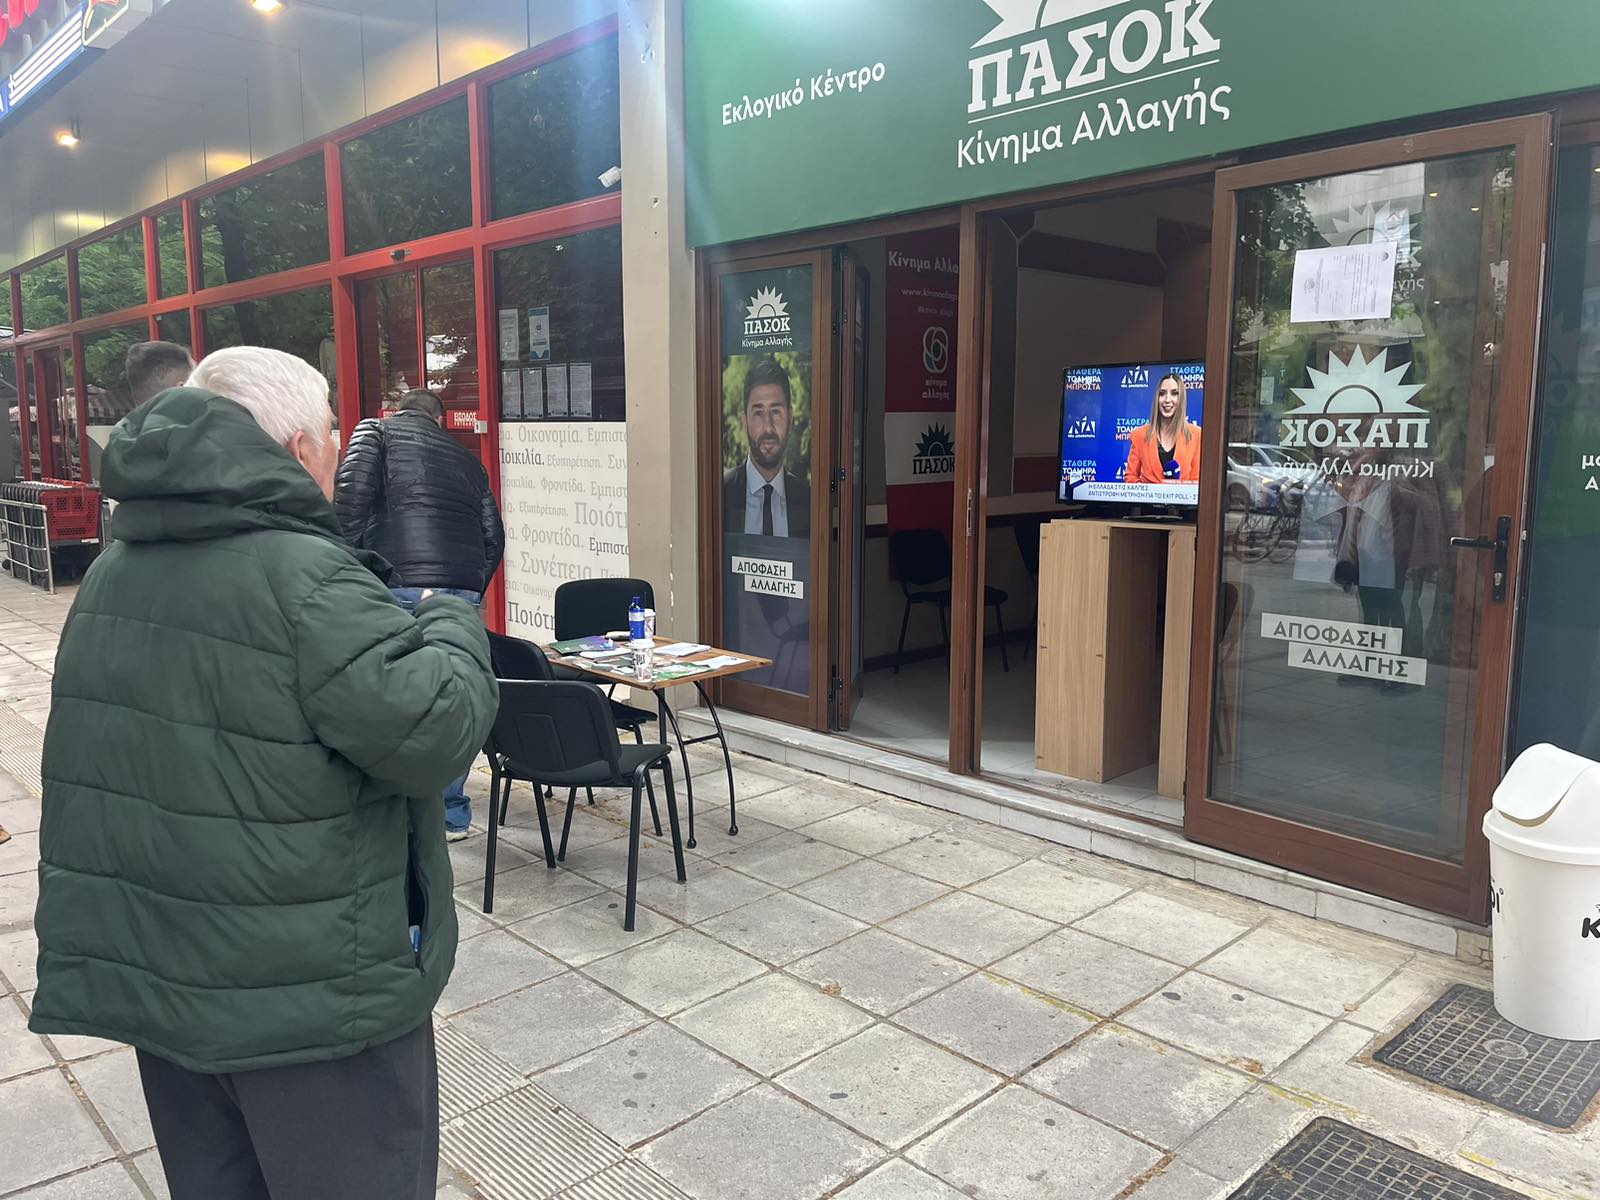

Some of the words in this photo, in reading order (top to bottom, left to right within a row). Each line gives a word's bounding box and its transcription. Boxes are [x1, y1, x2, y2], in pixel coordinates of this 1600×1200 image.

[967, 0, 1221, 114] ΠΑΣΟΚ
[721, 78, 804, 126] Εκλογικό
[810, 62, 886, 100] Κέντρο
[957, 123, 1063, 168] Κίνημα
[1072, 78, 1232, 145] Αλλαγής
[888, 250, 931, 273] Κίνημα
[744, 317, 791, 335] ΠΑΣΟΚ
[742, 338, 764, 349] Κίνημα
[765, 335, 793, 347] Αλλαγής
[1066, 383, 1101, 391] ΜΠΡΟΣΤΑ
[1116, 418, 1150, 426] ΣΤΑΘΕΡΑ
[518, 425, 583, 448] Οικονομία.
[1062, 459, 1097, 467] ΣΤΑΘΕΡΑ
[541, 477, 586, 495] Φροντίδα.
[521, 524, 584, 548] Φροντίδα.
[737, 561, 787, 577] ΑΠΟΦΑΣΗ
[751, 578, 797, 594] ΑΛΛΑΓΗΣ
[1273, 621, 1387, 650] ΑΠΟΦΑΣΗ
[1302, 648, 1409, 677] ΑΛΛΑΓΗΣ
